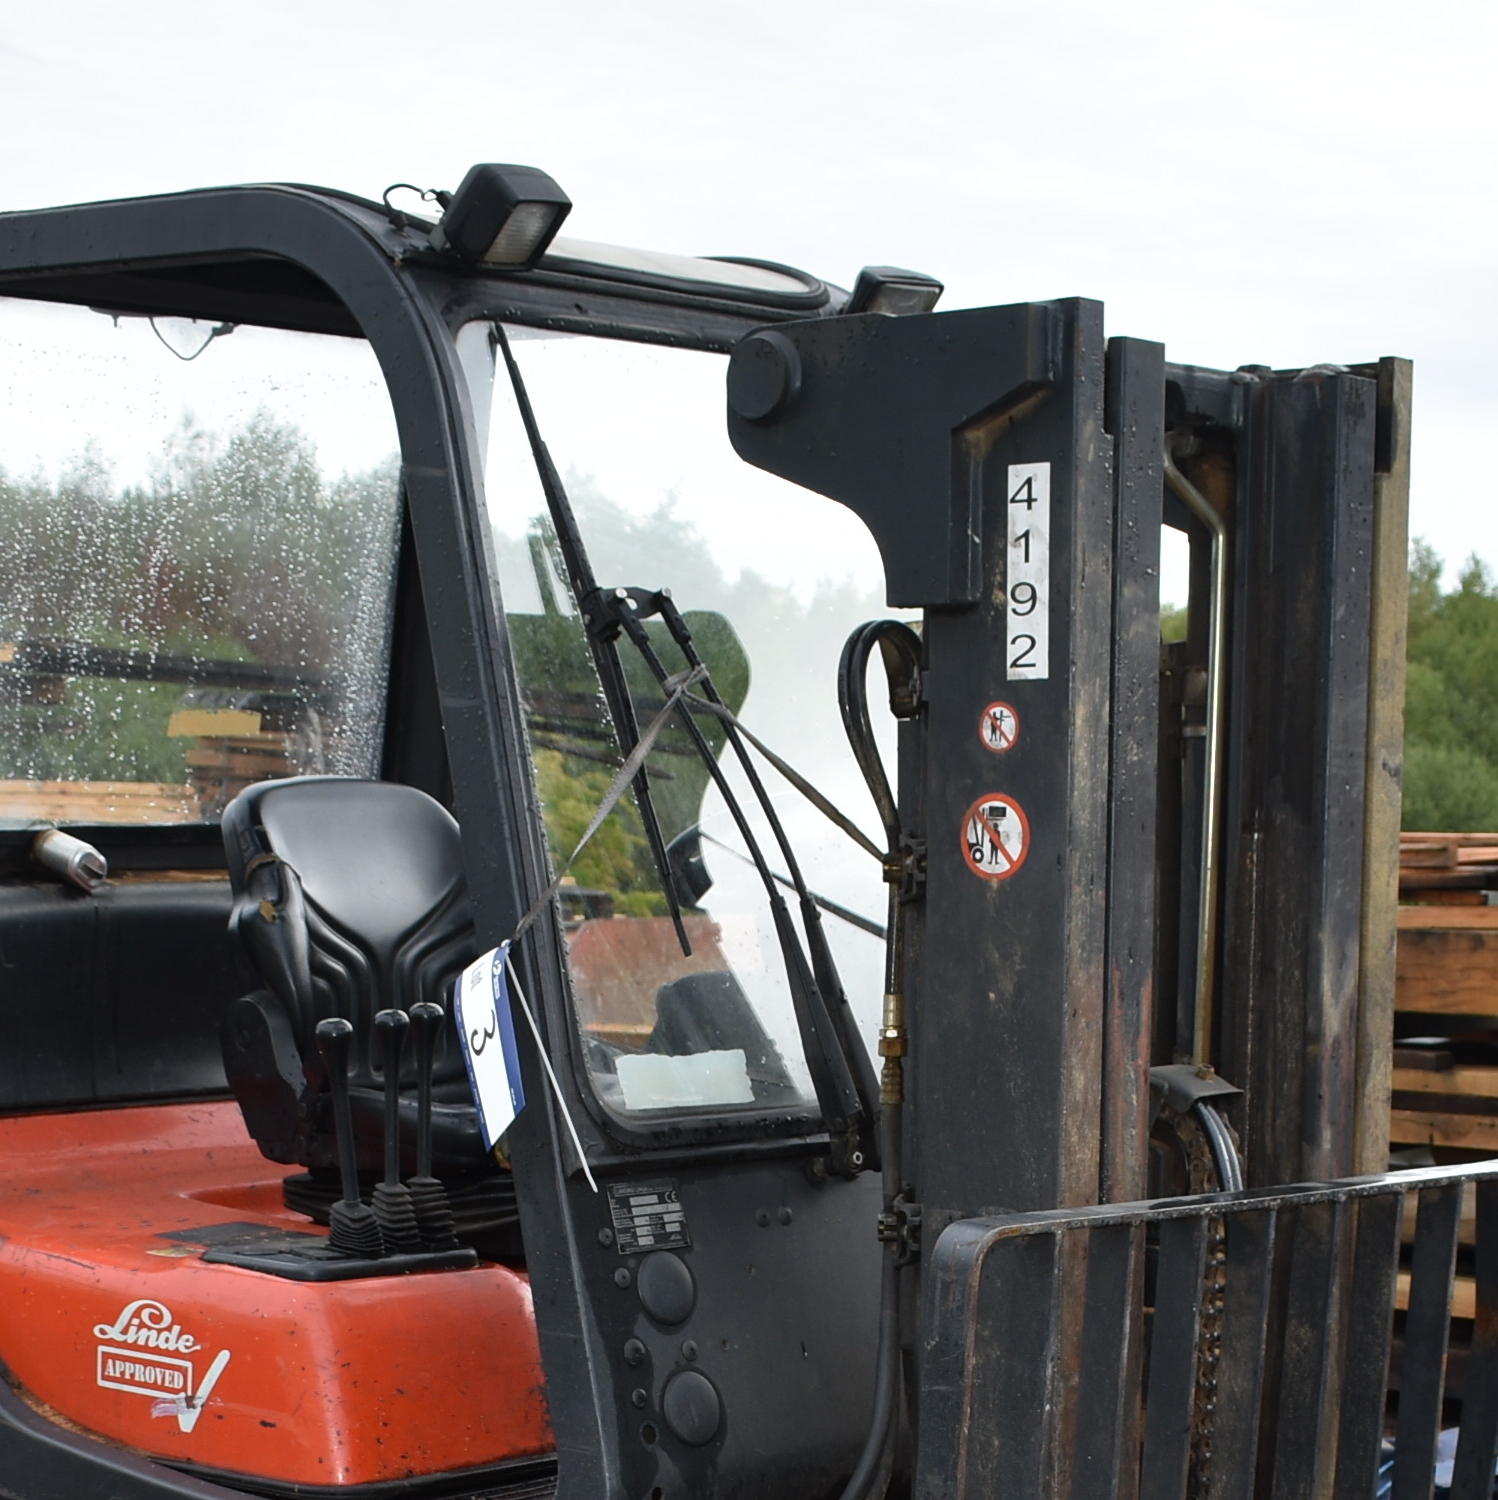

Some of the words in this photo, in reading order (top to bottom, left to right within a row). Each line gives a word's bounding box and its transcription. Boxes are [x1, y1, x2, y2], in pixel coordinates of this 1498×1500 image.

[1009, 476, 1038, 669] 4192
[471, 1009, 495, 1056] 3
[93, 1299, 201, 1354] Linde
[104, 1358, 184, 1389] APPROVED
